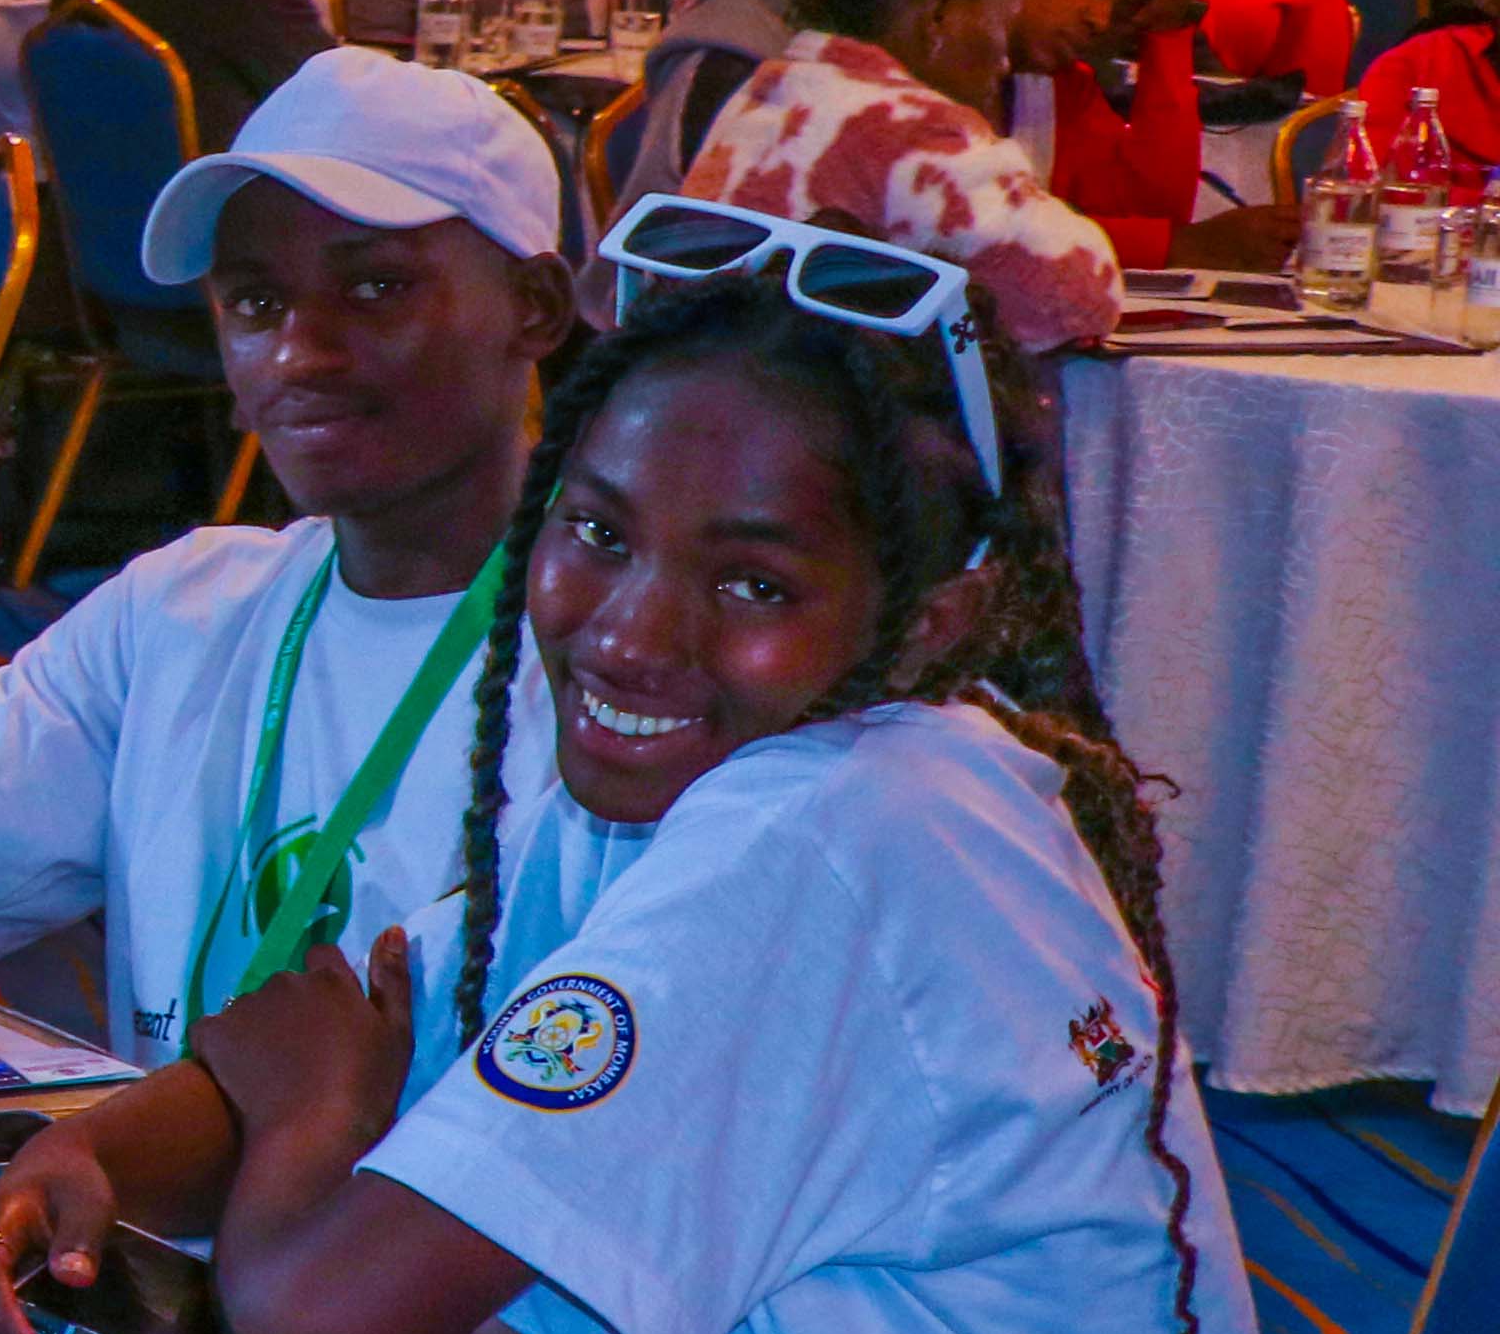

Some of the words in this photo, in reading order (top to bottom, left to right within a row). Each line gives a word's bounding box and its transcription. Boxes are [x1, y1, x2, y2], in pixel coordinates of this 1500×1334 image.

[527, 978, 623, 1010] GOVERNMENT
[615, 1014, 630, 1036] OF
[573, 1040, 630, 1100] MOMBASA
